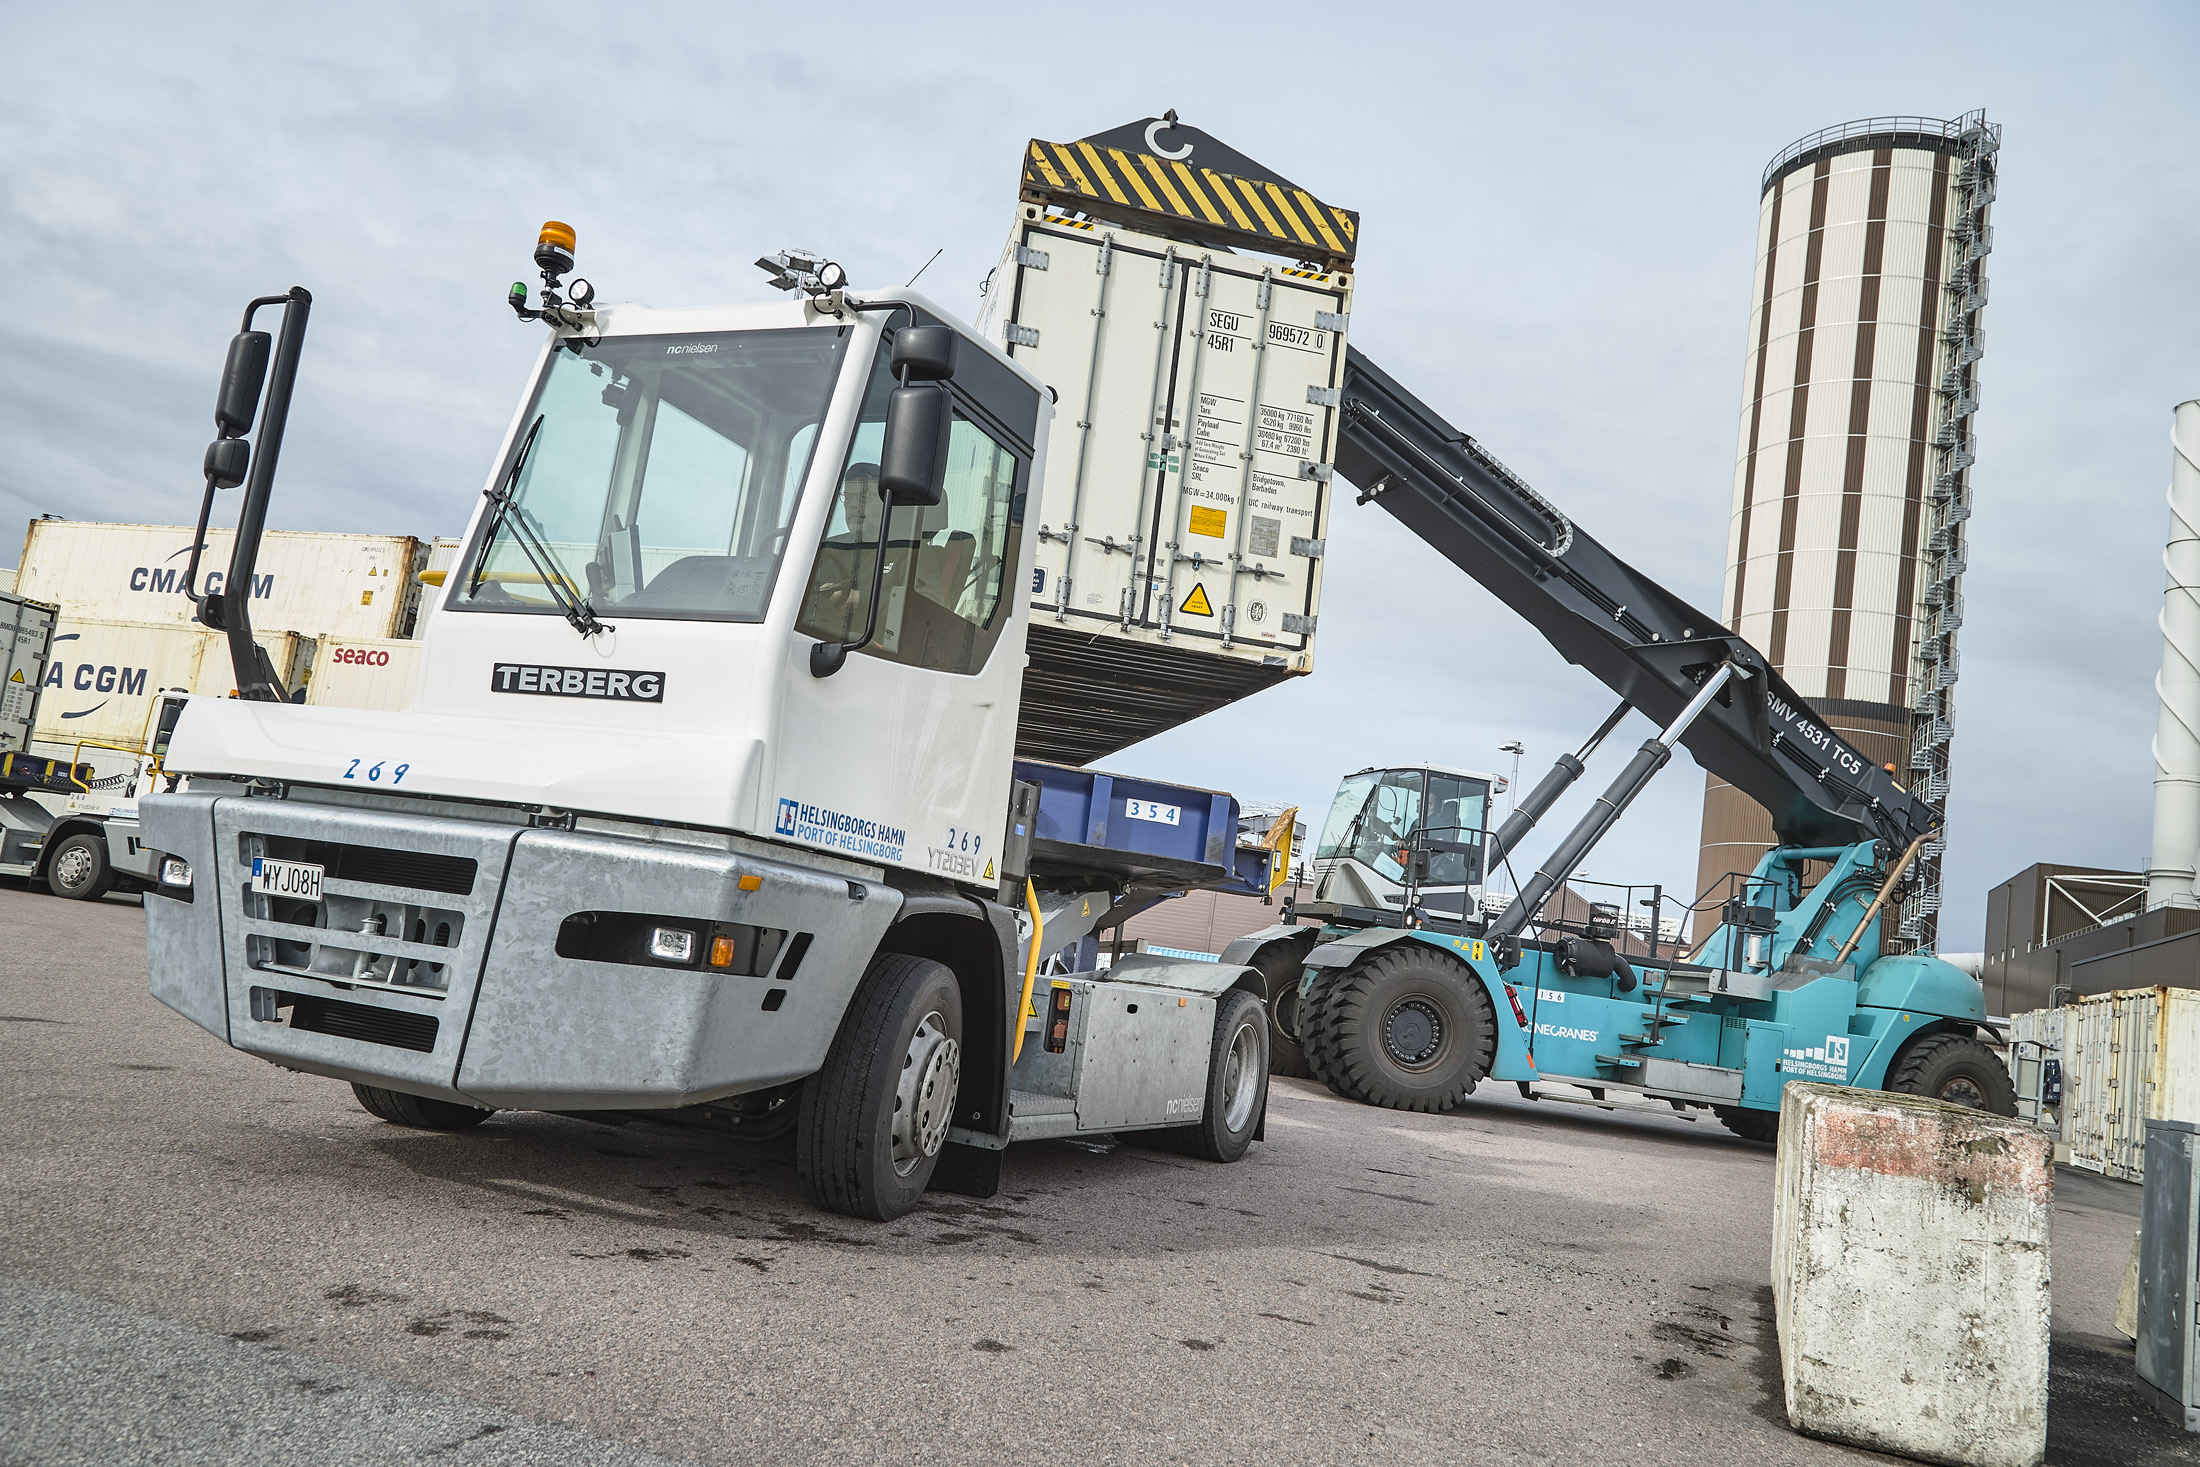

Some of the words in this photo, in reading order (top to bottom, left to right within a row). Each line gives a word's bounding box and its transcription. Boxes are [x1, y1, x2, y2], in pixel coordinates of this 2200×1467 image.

[1210, 312, 1239, 331] SEGU
[1269, 324, 1310, 346] 969572
[1316, 334, 1324, 348] 0
[666, 342, 718, 354] ncnielsen
[1207, 334, 1234, 352] 45R1
[1200, 396, 1217, 406] MGW
[1278, 411, 1285, 421] kg
[1200, 405, 1211, 414] Tare
[1263, 417, 1277, 427] 4520
[1277, 420, 1284, 430] kg
[1196, 427, 1211, 437] Cube
[1261, 440, 1274, 449] 67.4
[1198, 418, 1220, 429] Payload
[1276, 433, 1283, 443] kg
[1192, 463, 1210, 473] Seaco
[1251, 483, 1278, 494] Barbados
[1248, 498, 1259, 507] UIC
[1286, 506, 1313, 517] transport
[204, 571, 274, 599] CM
[332, 648, 389, 667] seaco
[73, 663, 148, 696] CGM
[496, 666, 660, 698] TERBERG
[1767, 691, 1798, 722] SMV
[1796, 720, 1831, 751] 4531
[1832, 744, 1862, 775] TC5
[799, 803, 877, 839] HELSINGBORGS
[877, 824, 906, 847] HAMN
[797, 823, 825, 843] PORT
[825, 830, 838, 846] OF
[839, 834, 903, 862] HELSINGBORG
[927, 846, 980, 878] YT203EV
[263, 864, 321, 897] WYJ08H
[1782, 1065, 1798, 1074] PORT
[1798, 1067, 1806, 1075] OF
[1806, 1069, 1847, 1081] HELSINGBORG
[1783, 1059, 1827, 1071] HELSINGBORGS
[1829, 1065, 1848, 1075] HAMN
